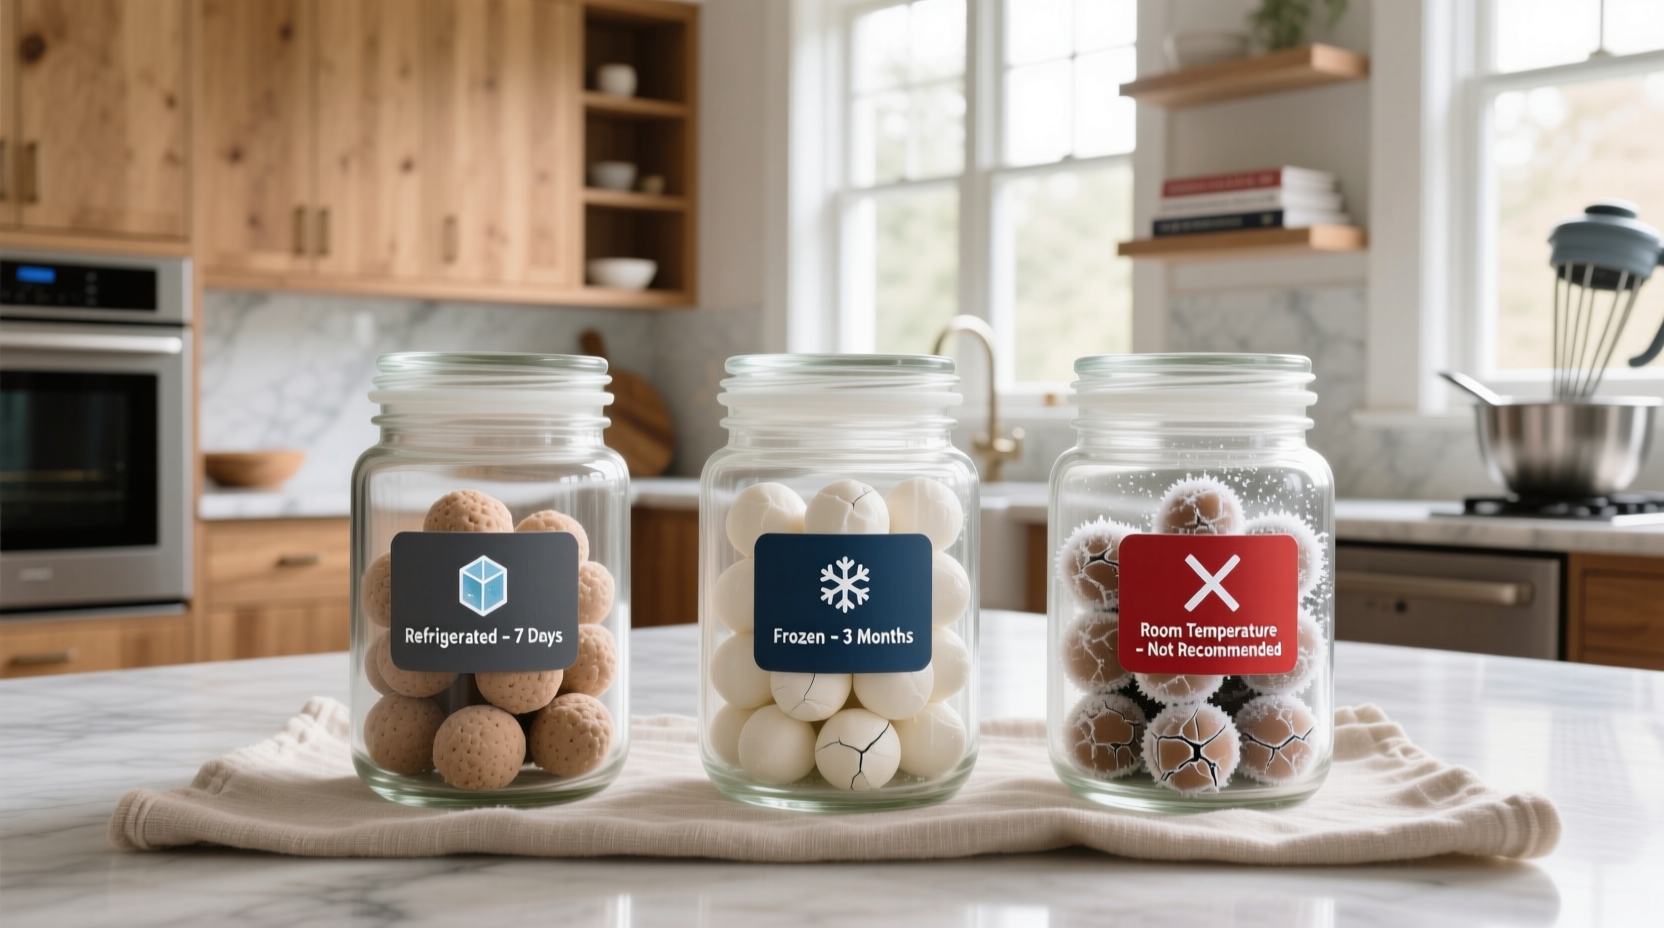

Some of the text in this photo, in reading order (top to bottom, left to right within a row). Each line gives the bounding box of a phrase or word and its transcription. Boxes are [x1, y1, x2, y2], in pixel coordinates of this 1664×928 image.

[405, 627, 498, 649] Refrigerated
[514, 627, 524, 644] 7
[528, 627, 563, 648] Days
[773, 627, 826, 645] Frozen
[842, 628, 853, 645] 3
[857, 626, 914, 645] Months
[1140, 622, 1278, 642] Room Temperature
[1147, 641, 1174, 657] Not
[1178, 641, 1282, 657] Recommended
